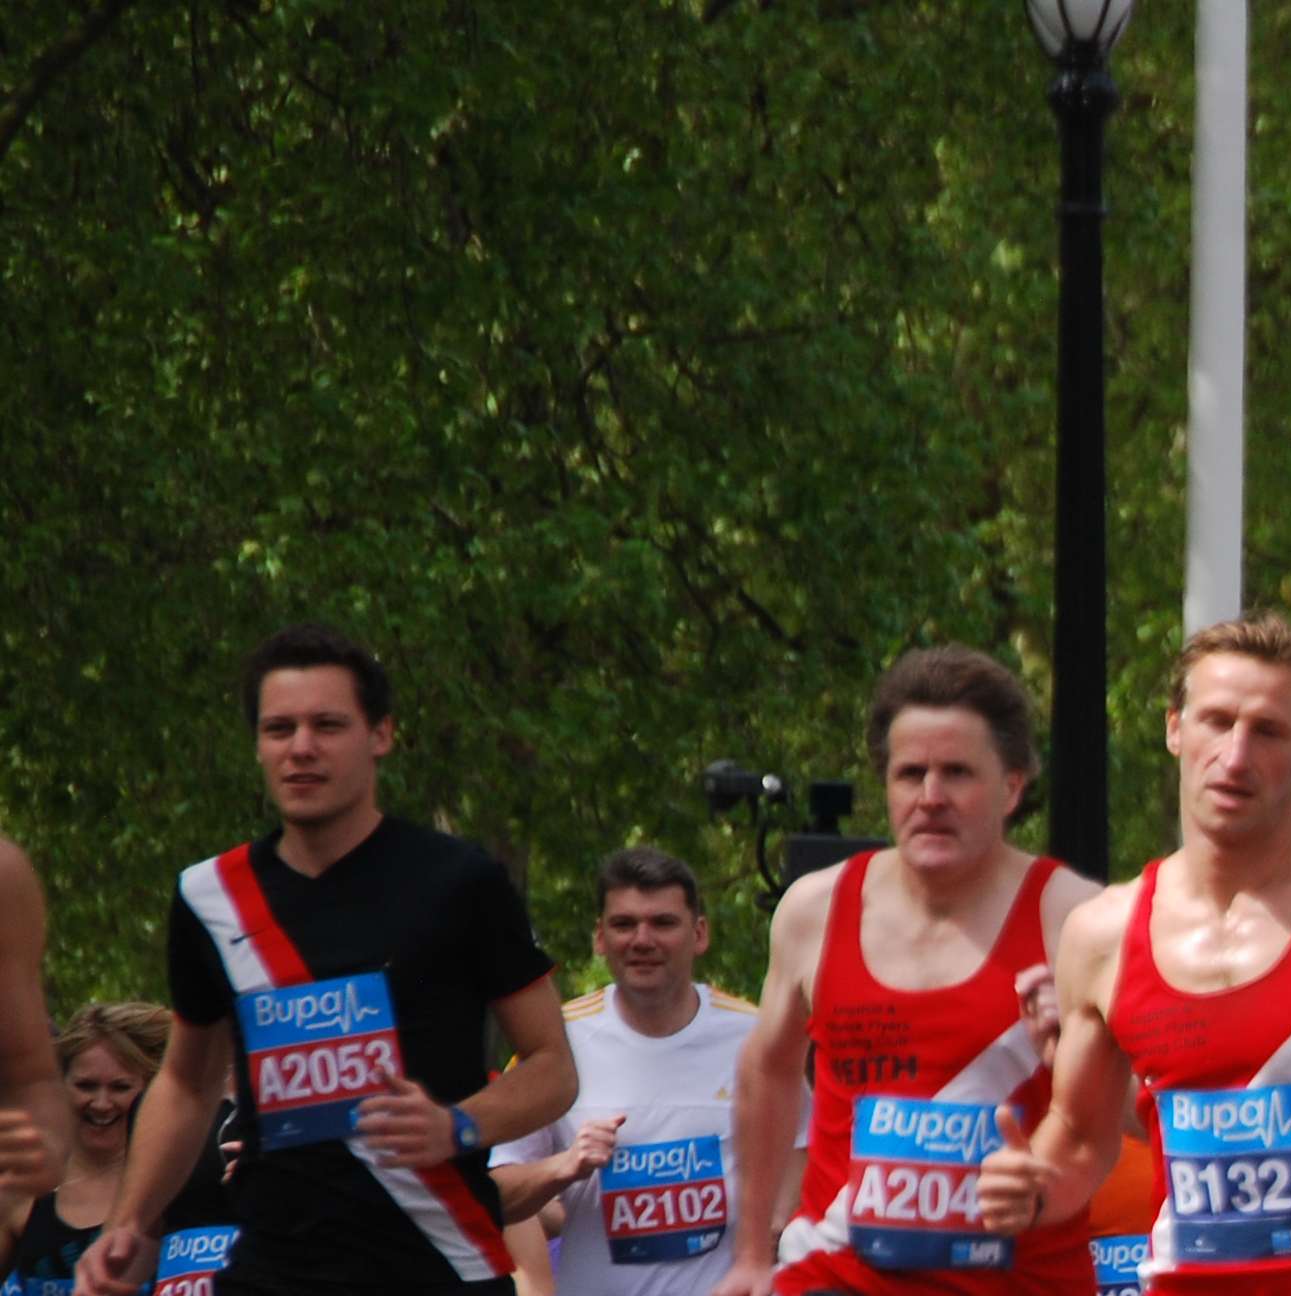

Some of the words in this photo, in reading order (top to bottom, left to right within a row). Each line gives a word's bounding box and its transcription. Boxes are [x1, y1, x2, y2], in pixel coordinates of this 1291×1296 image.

[255, 989, 343, 1031] Bupa
[258, 1039, 397, 1105] A2053
[868, 1099, 973, 1151] Bupa
[1171, 1093, 1266, 1142] Bupa
[611, 1147, 686, 1177] Bupa
[610, 1183, 725, 1233] A2102
[852, 1164, 981, 1224] A204
